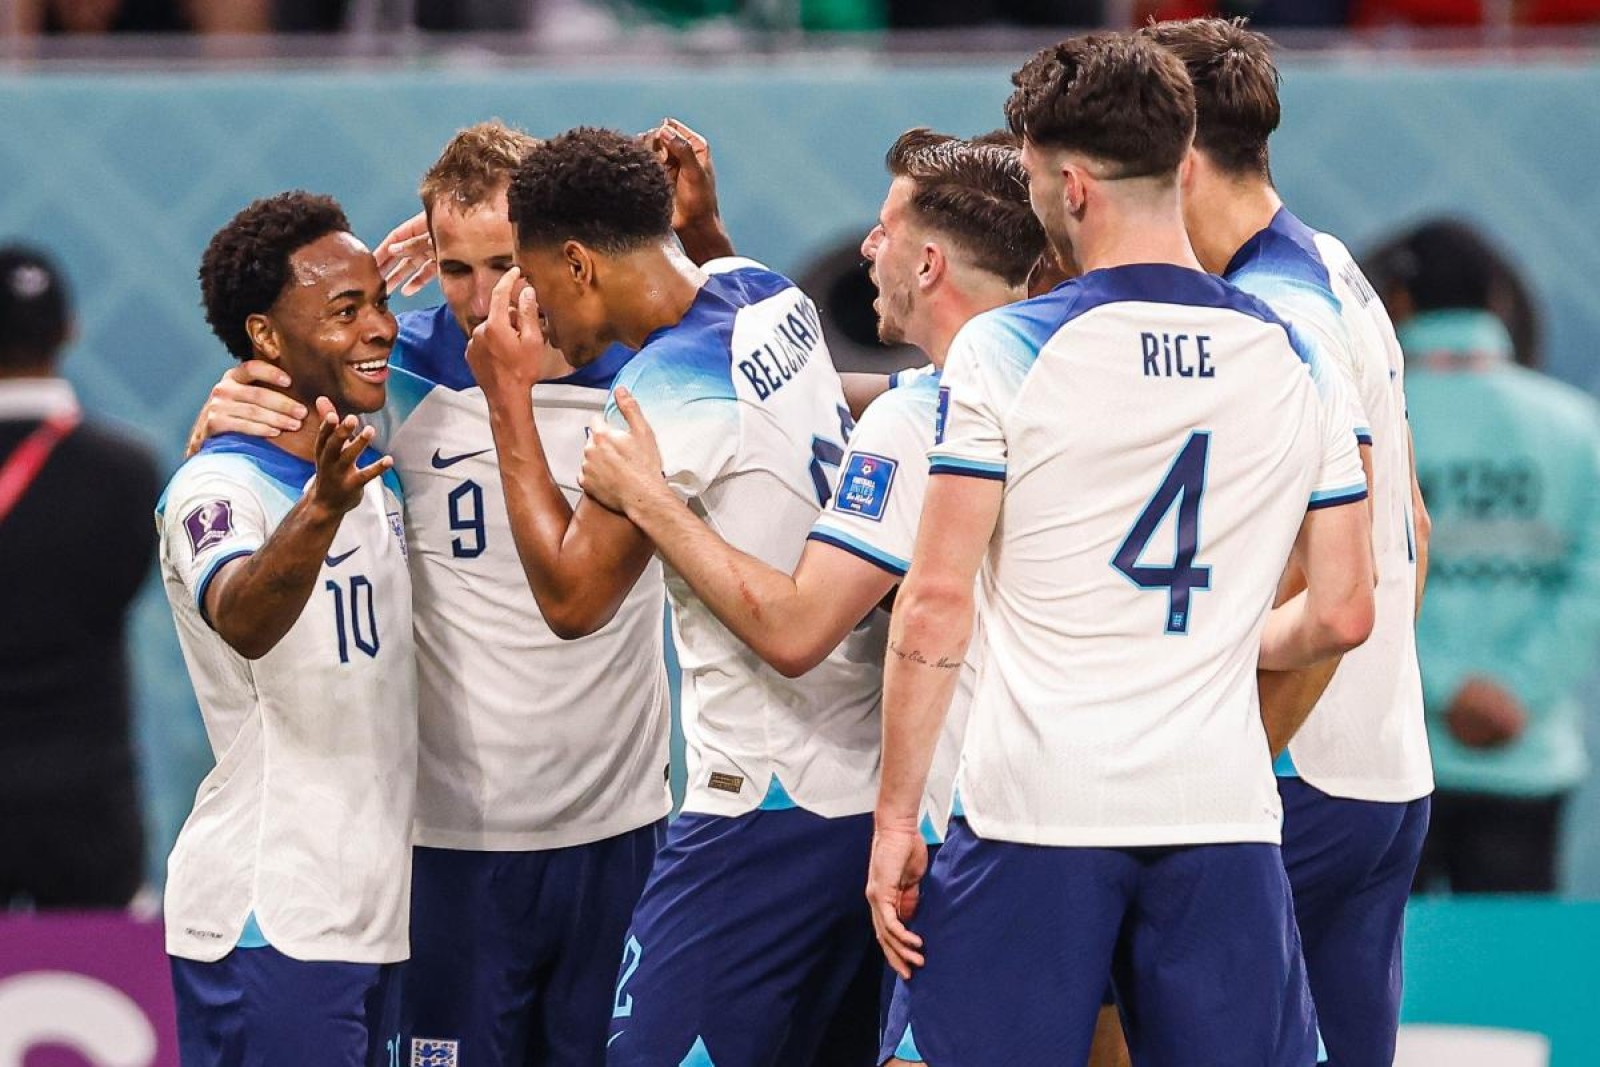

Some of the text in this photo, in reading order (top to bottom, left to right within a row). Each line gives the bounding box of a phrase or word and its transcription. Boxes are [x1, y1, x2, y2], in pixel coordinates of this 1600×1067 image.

[447, 479, 487, 559] 9
[1107, 428, 1213, 636] 4
[325, 574, 380, 664] 10
[612, 934, 643, 1018] 2
